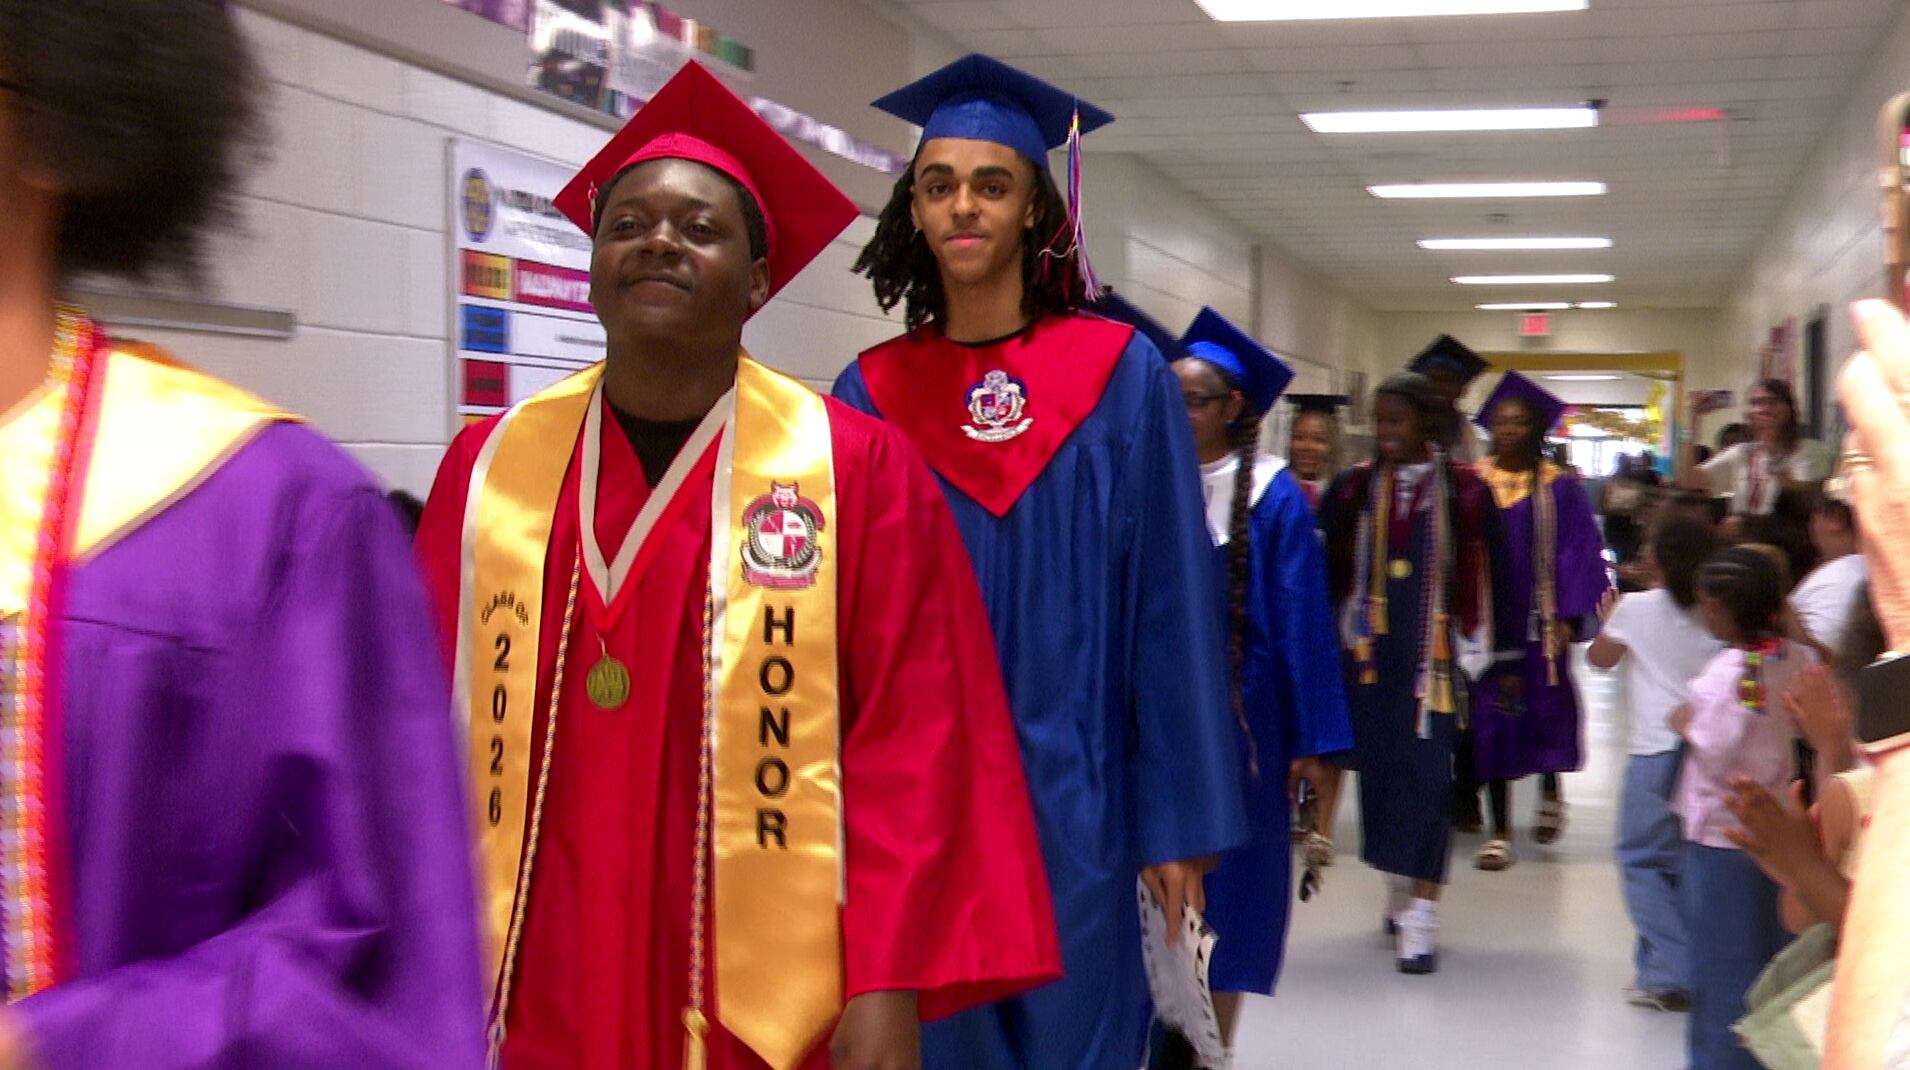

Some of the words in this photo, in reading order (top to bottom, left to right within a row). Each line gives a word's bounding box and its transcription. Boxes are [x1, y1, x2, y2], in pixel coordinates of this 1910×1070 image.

[516, 602, 529, 627] OF
[488, 633, 511, 828] 2026
[755, 605, 795, 850] HONOR
